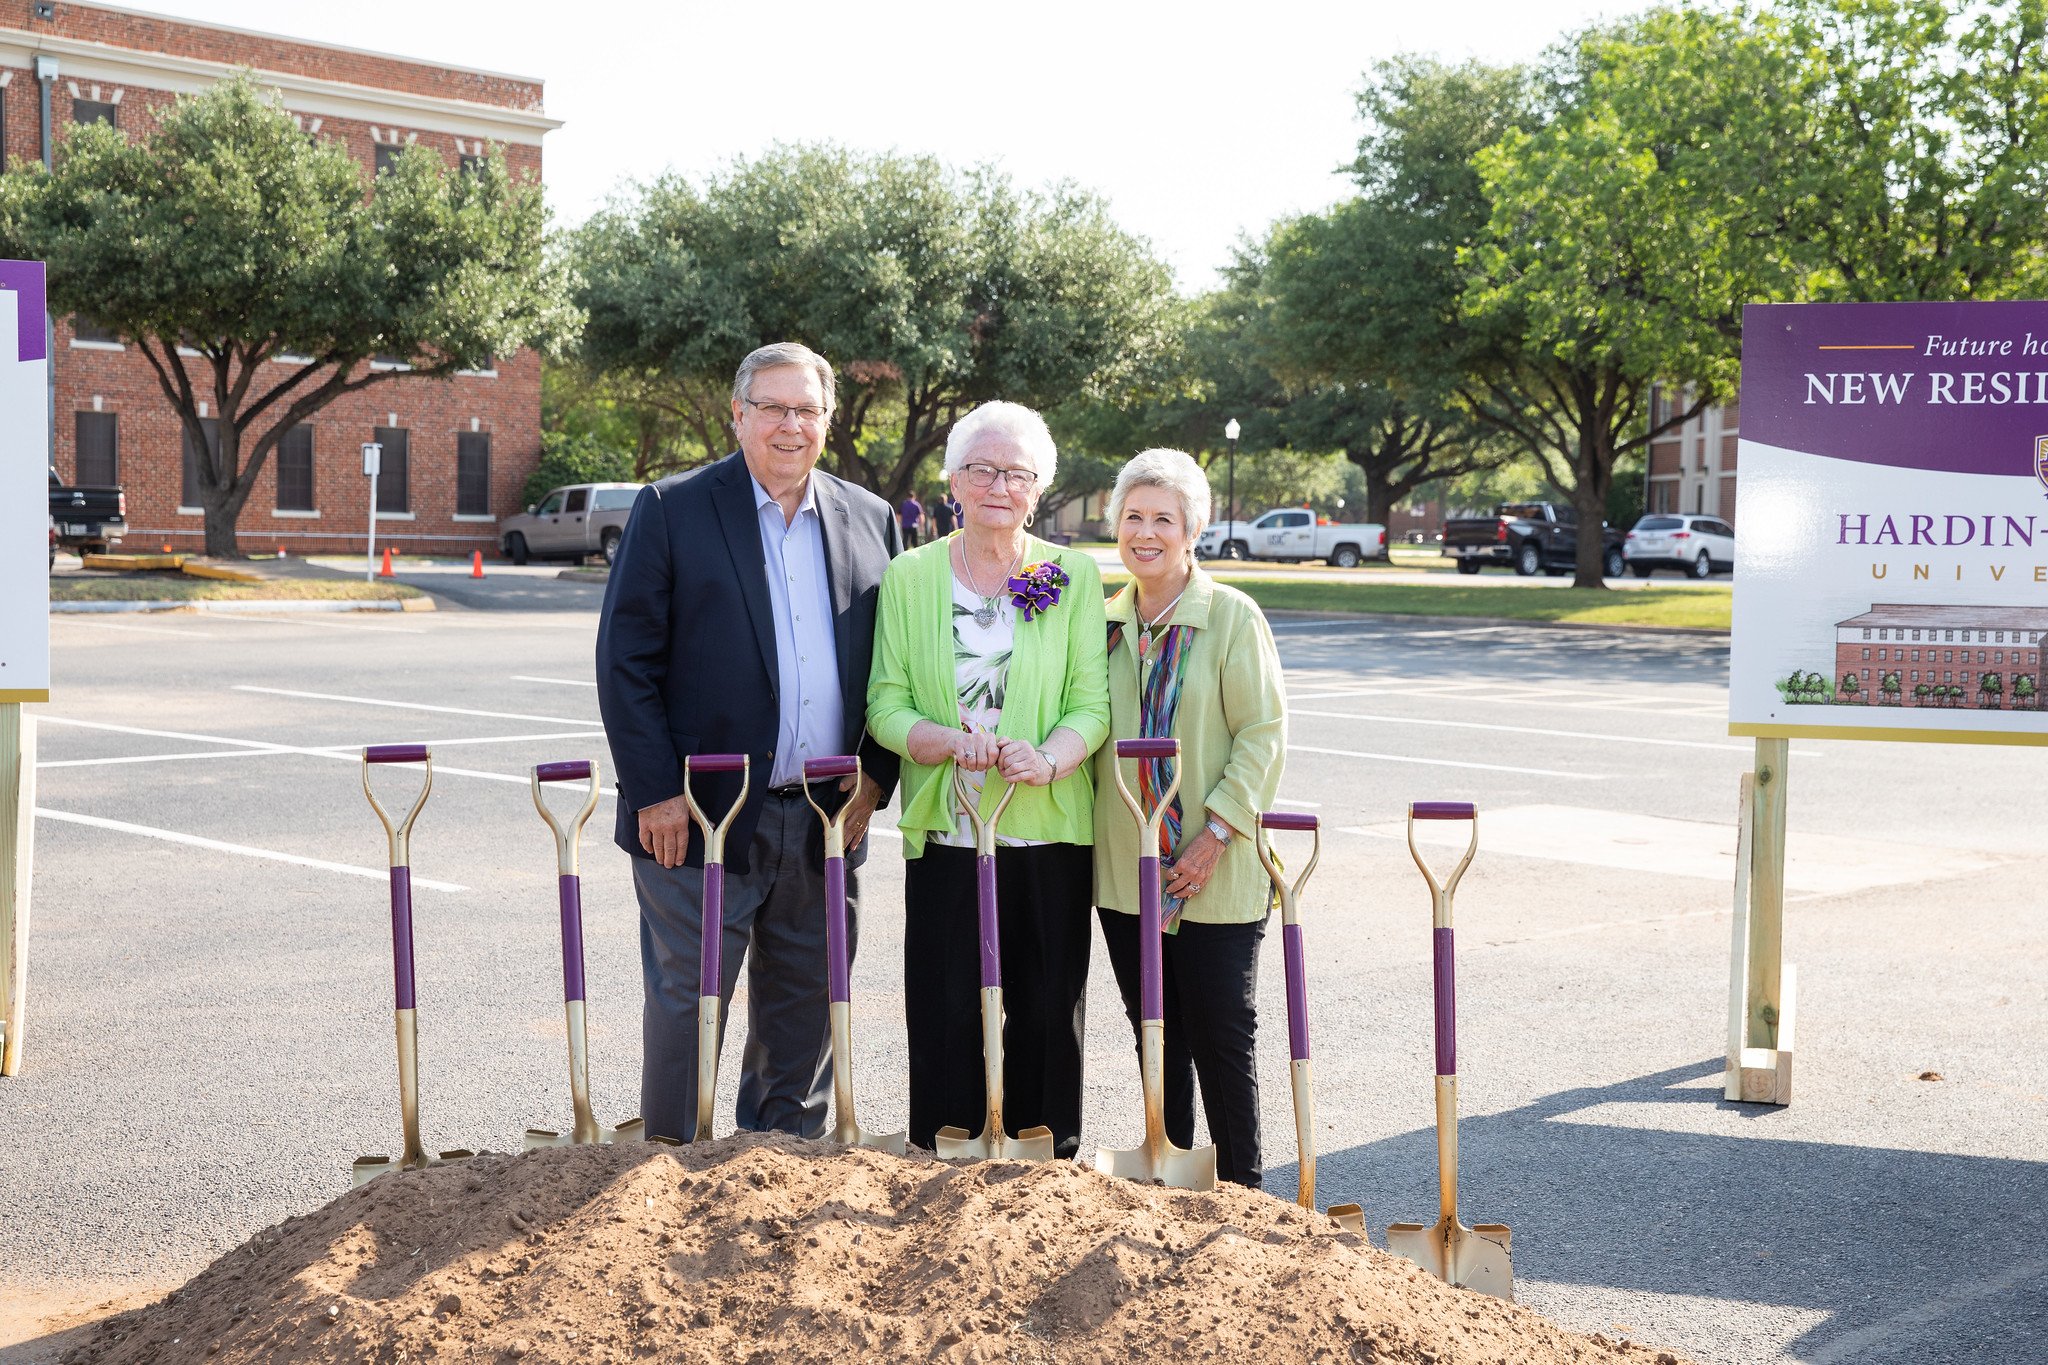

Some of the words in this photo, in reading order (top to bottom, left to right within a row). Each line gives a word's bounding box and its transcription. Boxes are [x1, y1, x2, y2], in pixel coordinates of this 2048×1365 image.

[1924, 335, 2013, 356] Future
[1804, 373, 1914, 404] NEW
[1872, 563, 2048, 582] UNIVE
